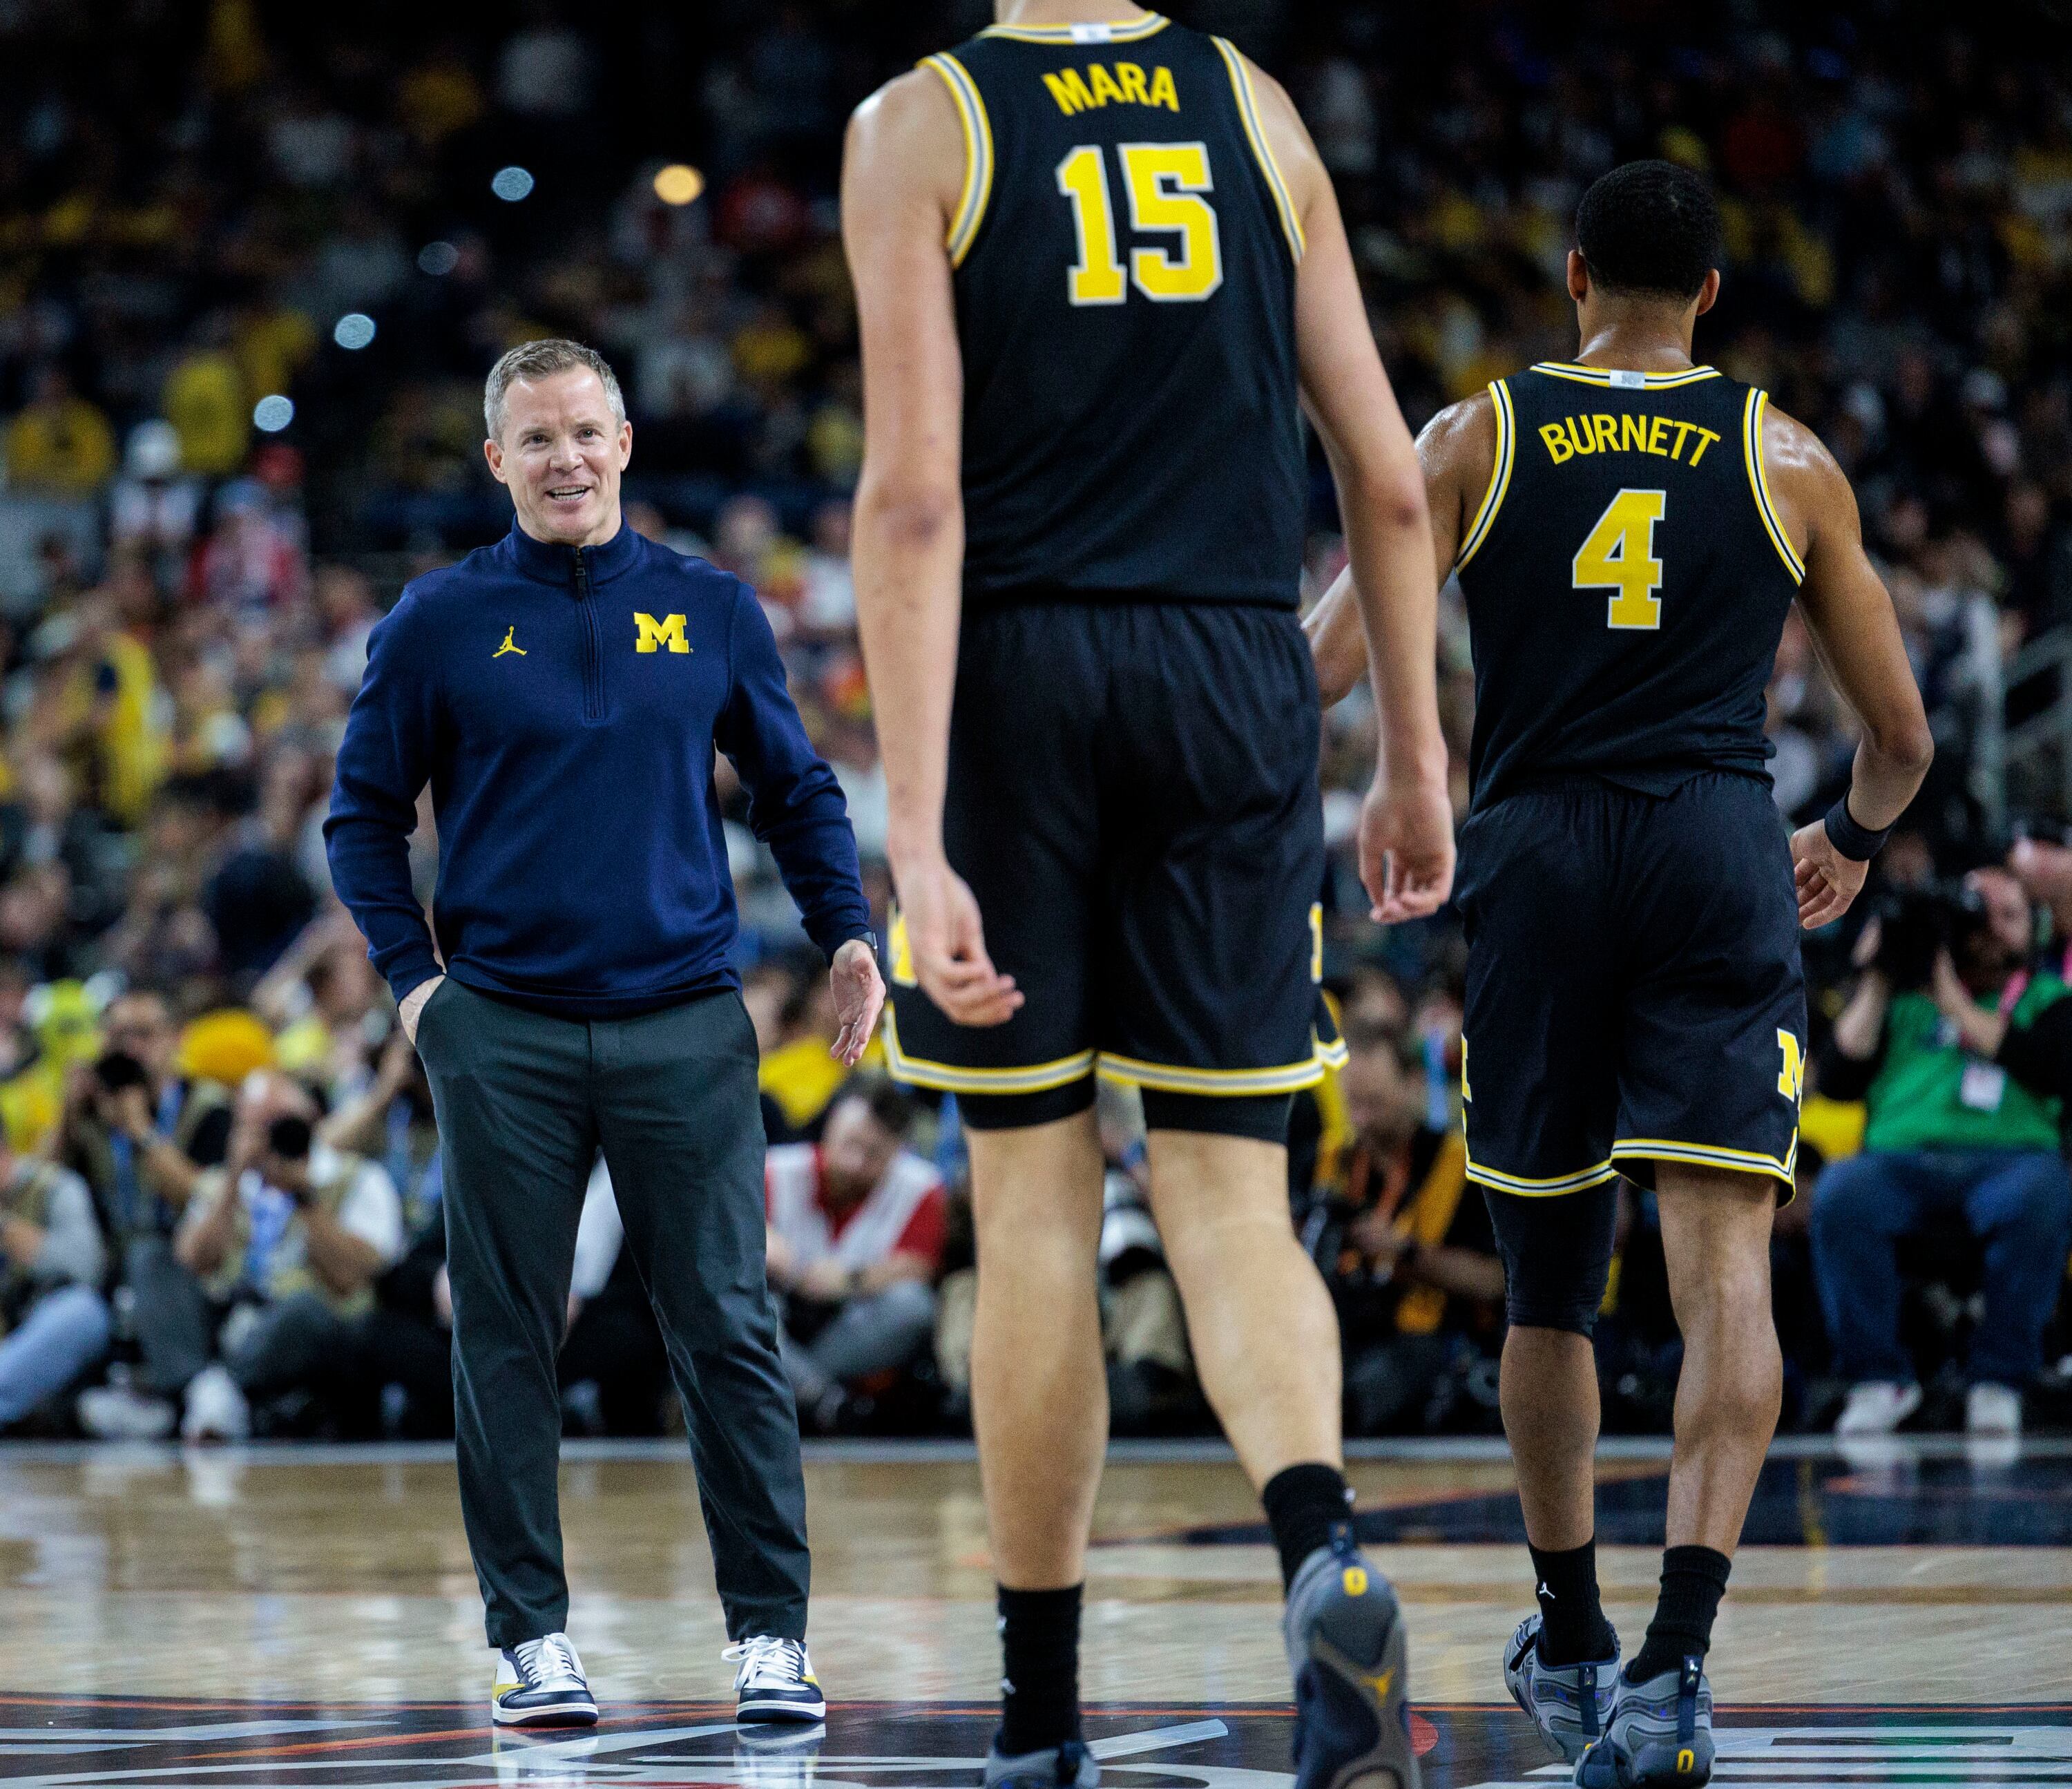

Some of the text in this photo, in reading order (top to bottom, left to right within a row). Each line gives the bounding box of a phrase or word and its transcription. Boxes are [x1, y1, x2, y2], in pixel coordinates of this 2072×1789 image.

[1041, 61, 1180, 116] MARA
[1054, 140, 1224, 307] 15
[1538, 414, 1721, 467] BURNETT
[1572, 488, 1667, 630] 4
[633, 612, 690, 653] M
